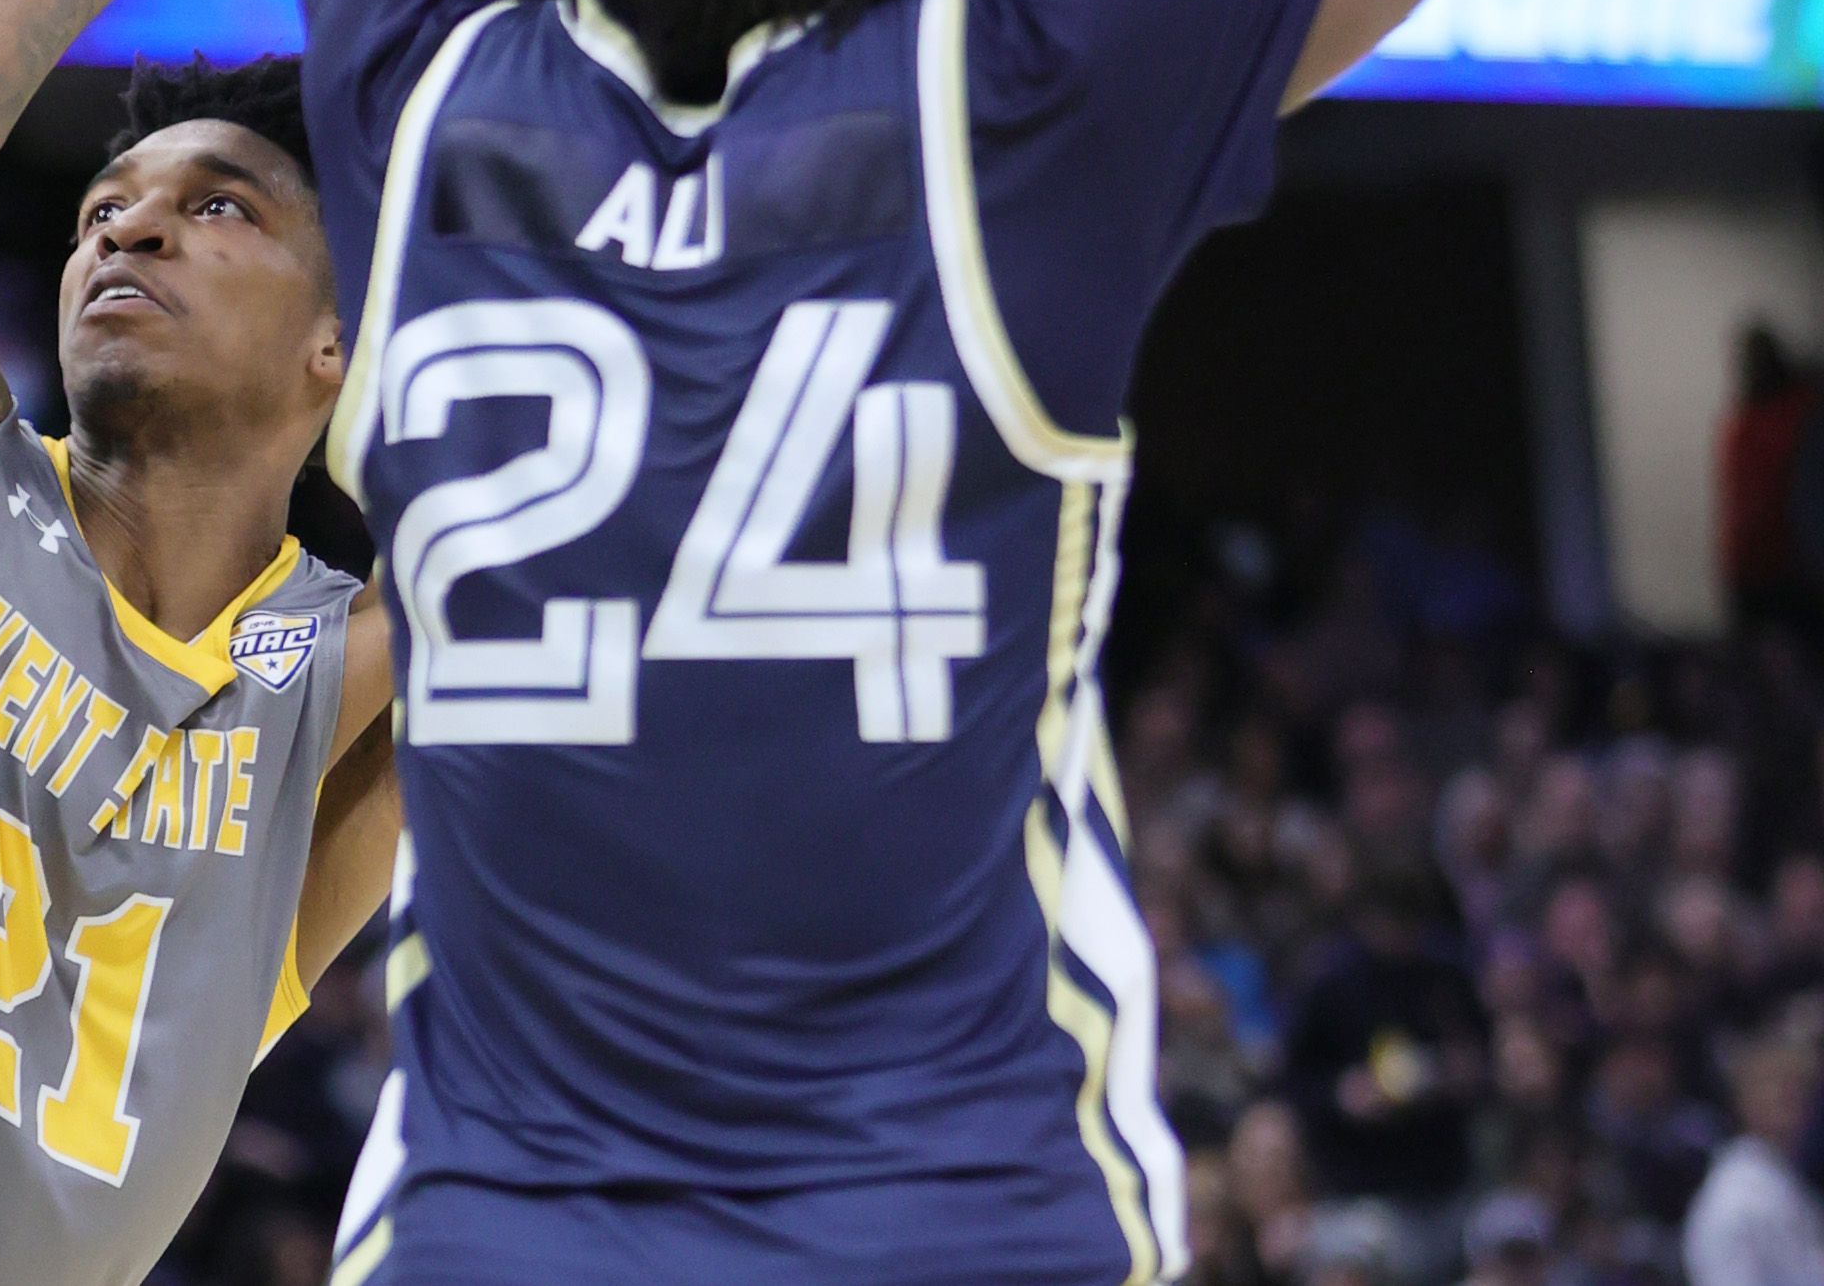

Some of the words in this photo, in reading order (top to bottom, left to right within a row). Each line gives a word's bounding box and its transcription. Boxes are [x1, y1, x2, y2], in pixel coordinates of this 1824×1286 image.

[381, 298, 988, 746] 24
[230, 626, 315, 657] MAC
[88, 723, 261, 857] SATE
